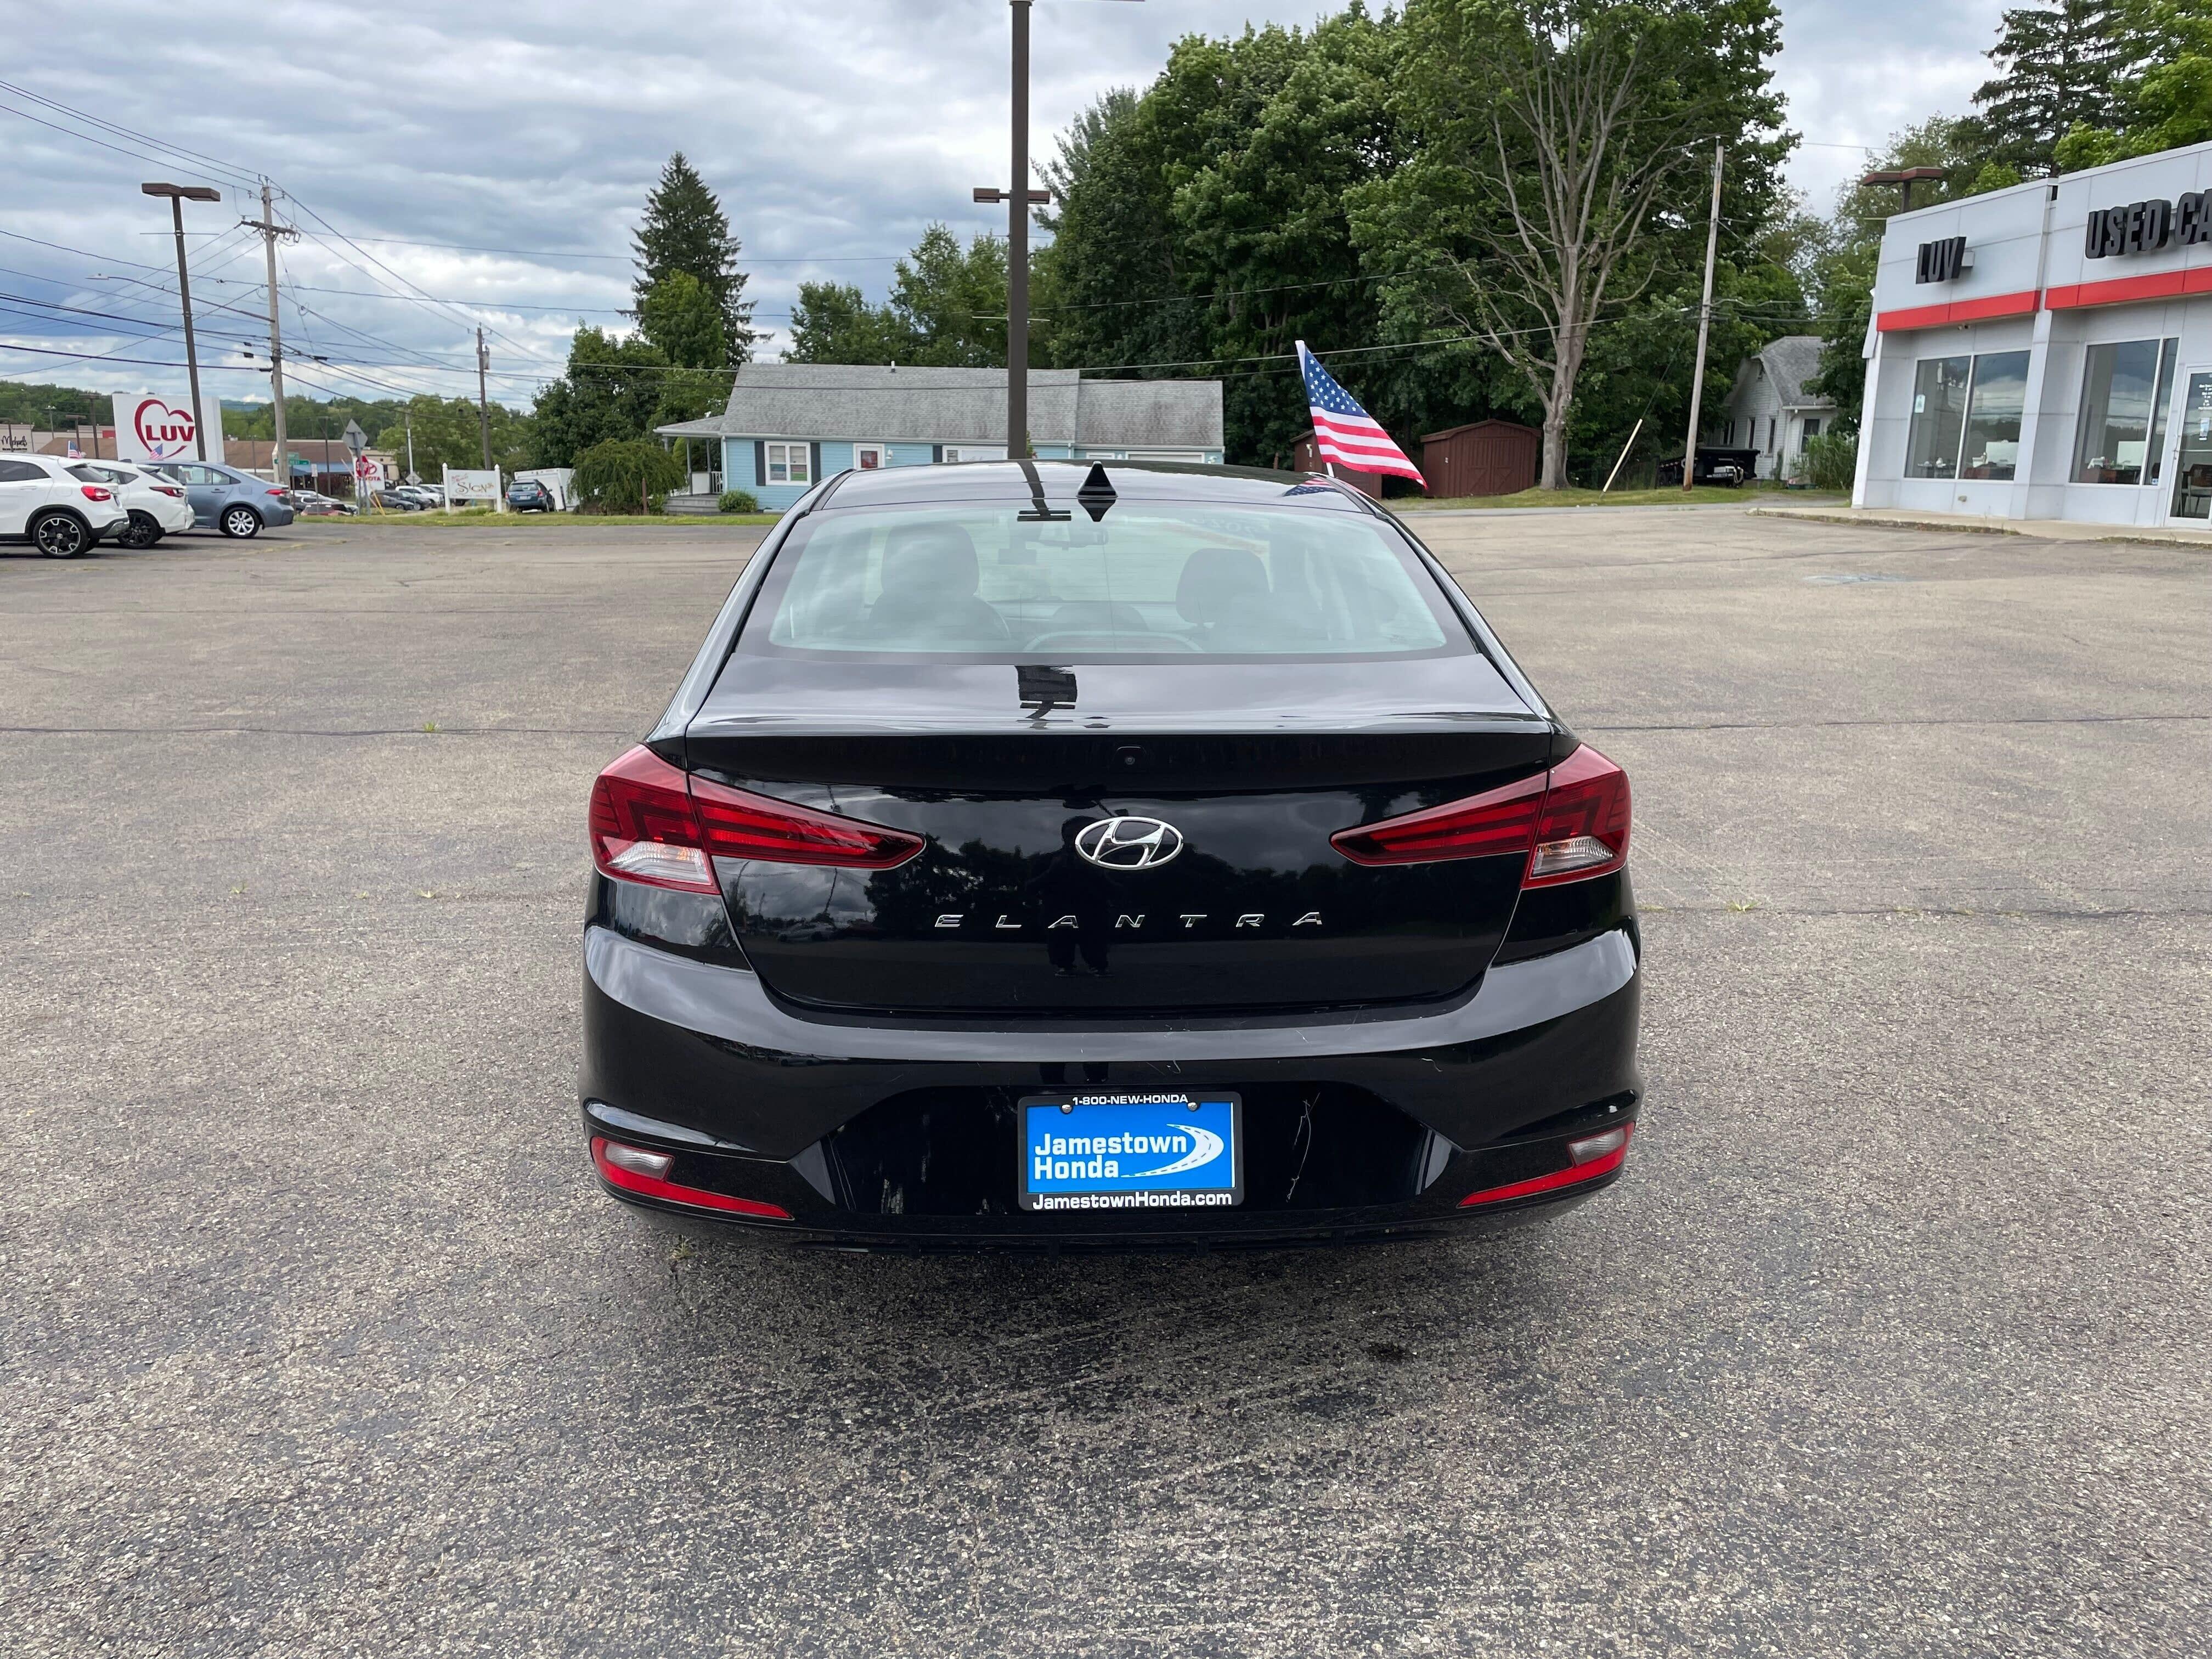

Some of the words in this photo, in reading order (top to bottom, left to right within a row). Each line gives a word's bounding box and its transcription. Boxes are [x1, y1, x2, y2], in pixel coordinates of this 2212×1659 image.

[2085, 199, 2171, 259] USED
[1916, 236, 1966, 284] LUV
[145, 425, 195, 442] LUV
[934, 911, 1322, 928] ELANTRA
[1072, 1094, 1189, 1105] 1-800-NEW-HONDA
[1035, 1132, 1187, 1155] Jamestown
[1034, 1154, 1119, 1180] Honda
[1032, 1190, 1232, 1210] JamestownHonda.com
